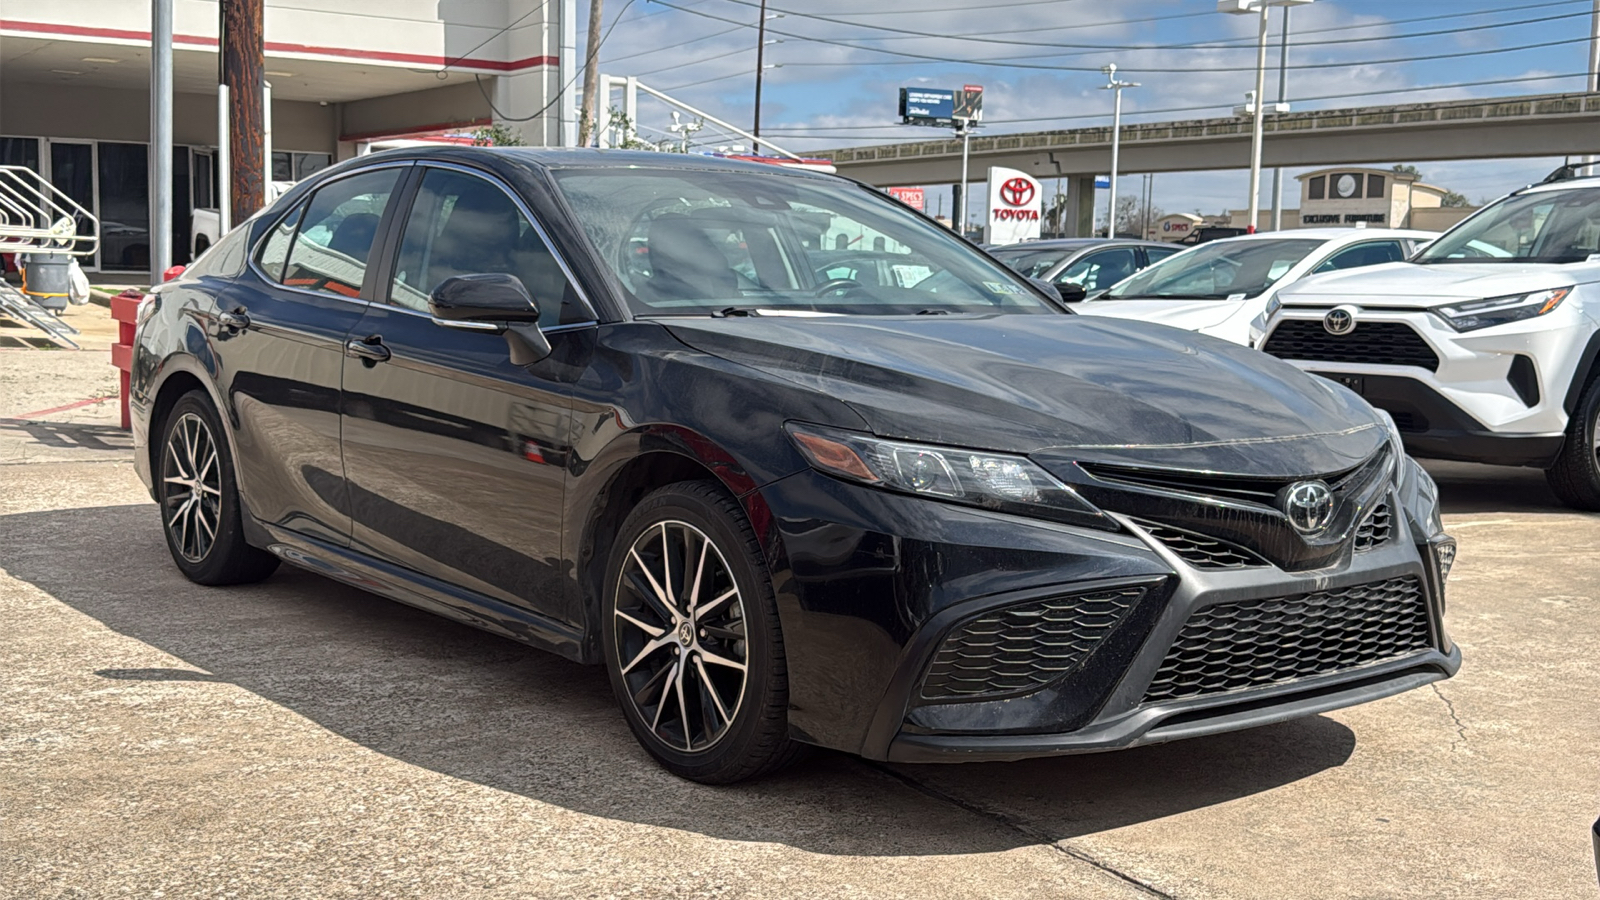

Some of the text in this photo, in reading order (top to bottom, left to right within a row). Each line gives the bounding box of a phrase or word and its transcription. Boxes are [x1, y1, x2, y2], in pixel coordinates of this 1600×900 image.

[993, 209, 1039, 221] TOYOTA
[1303, 213, 1386, 224] EXCLUSIVE FURNITURE
